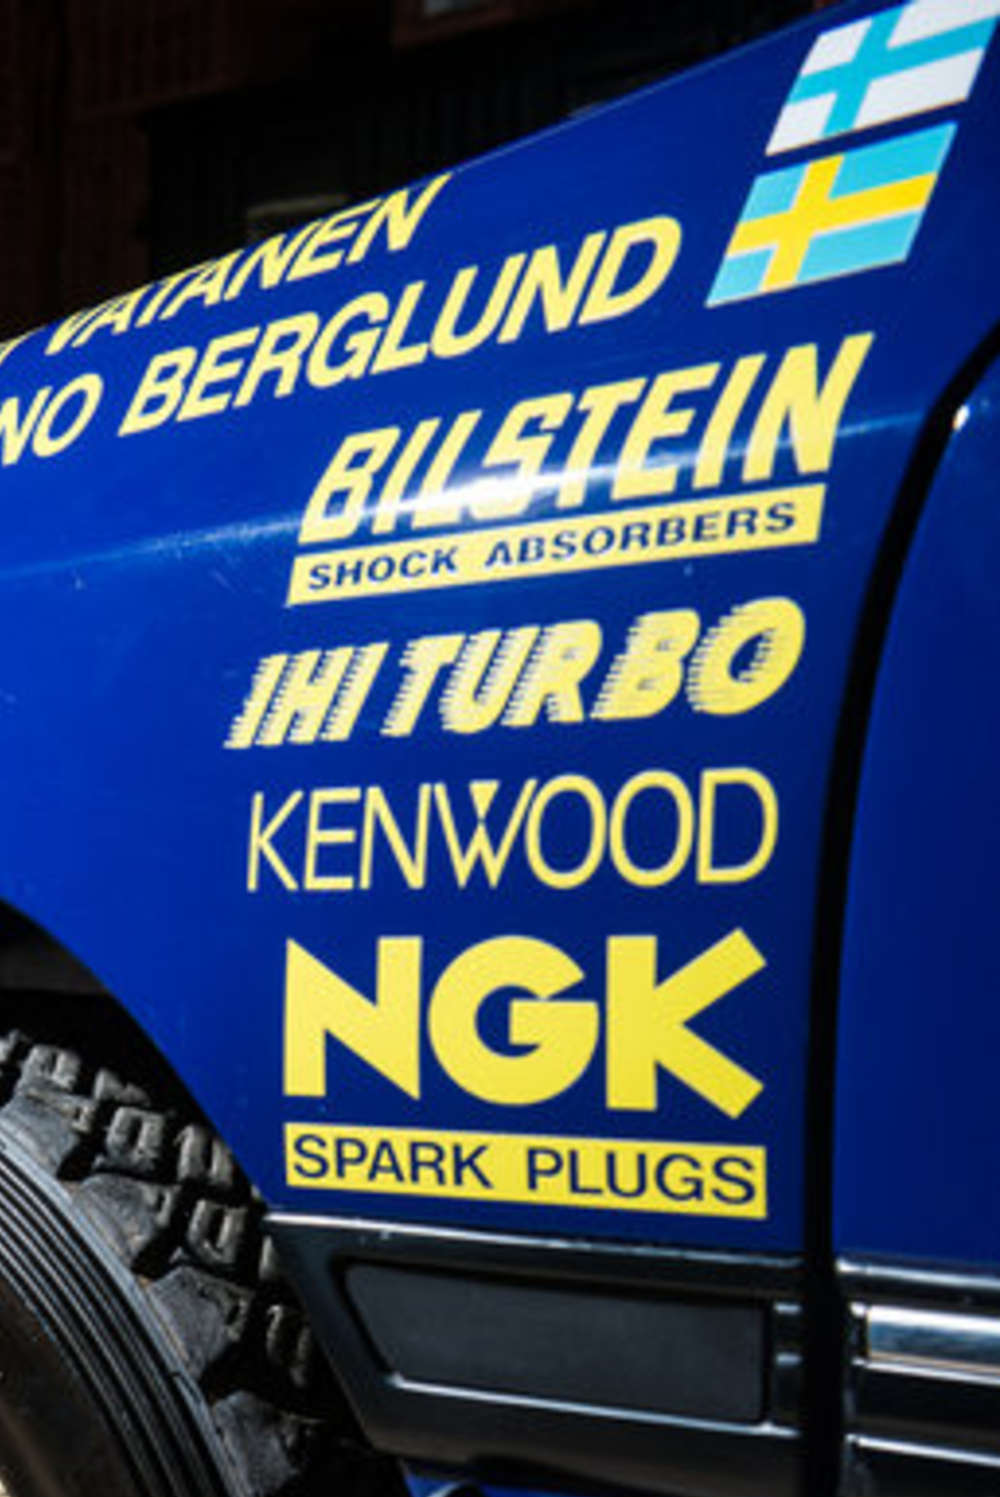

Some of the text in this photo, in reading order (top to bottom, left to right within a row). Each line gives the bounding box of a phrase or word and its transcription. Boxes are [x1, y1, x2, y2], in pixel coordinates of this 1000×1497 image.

[44, 172, 452, 356] VATANEN
[117, 216, 683, 438] BERGLUND
[297, 332, 874, 545] BILSTEIN
[308, 502, 796, 591] SHOCK ABSORBERS
[224, 597, 806, 750] IHI TURBO
[246, 767, 779, 891] KENWOOD
[282, 929, 767, 1119] NGK
[292, 1132, 758, 1207] SPARK PLUGS
